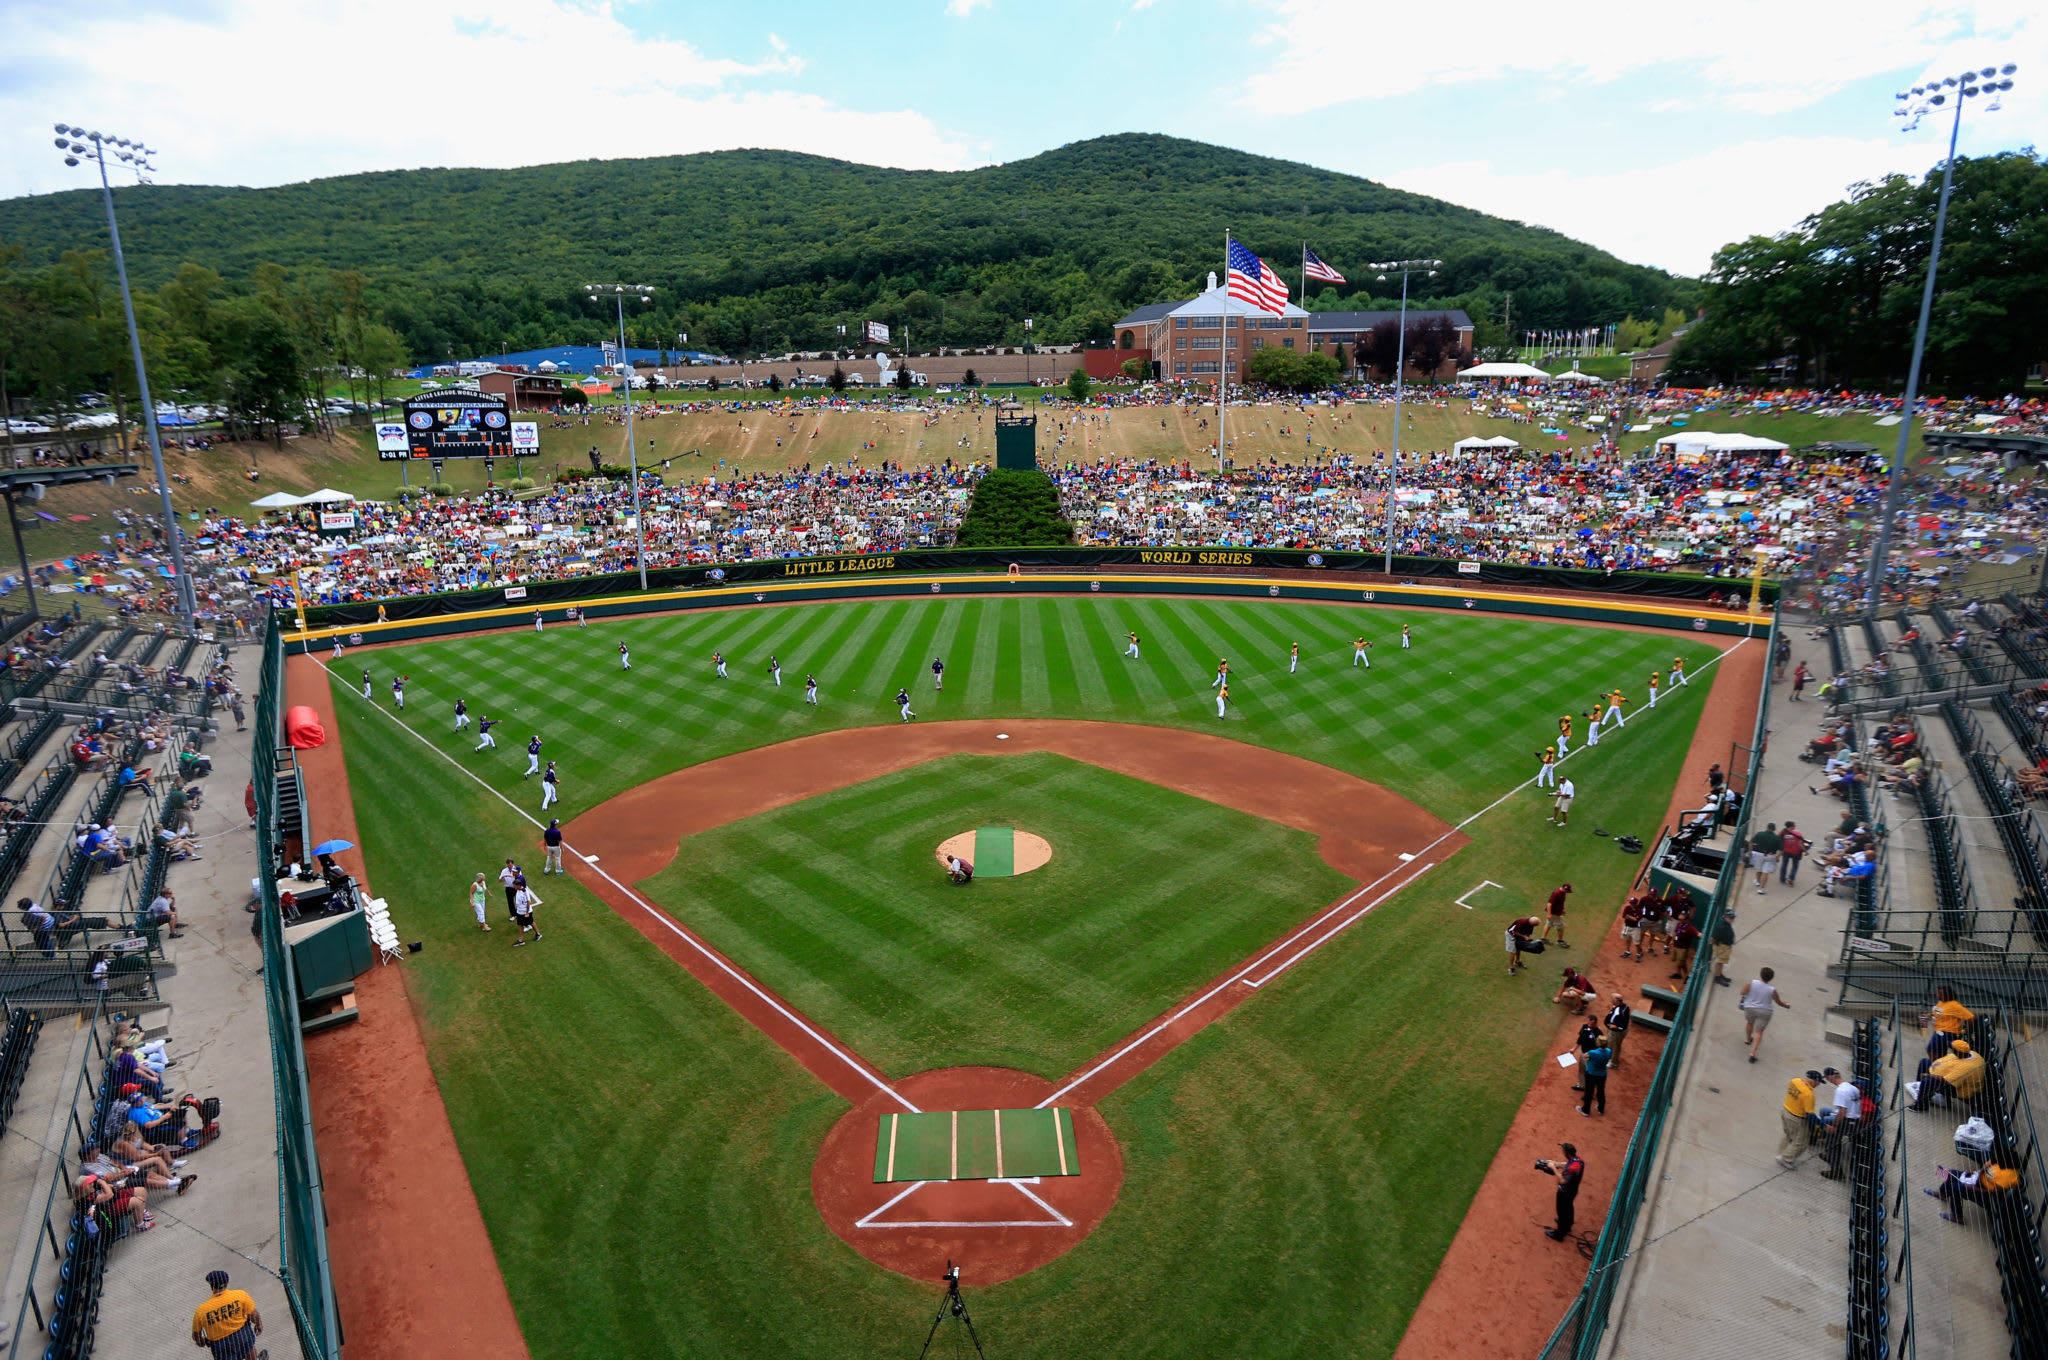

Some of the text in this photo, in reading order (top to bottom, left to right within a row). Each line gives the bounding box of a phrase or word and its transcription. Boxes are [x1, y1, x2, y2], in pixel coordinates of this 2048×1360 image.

[414, 393, 434, 402] LITTLE
[433, 390, 456, 398] LEAGUE
[478, 392, 498, 402] SERIES
[323, 516, 352, 524] ESPN
[1140, 551, 1253, 565] WORLD SERIES
[784, 556, 895, 576] LITTLE LEAGUE
[506, 588, 525, 596] ESPN
[206, 1299, 240, 1319] EVENT
[207, 1307, 241, 1326] STAFF
